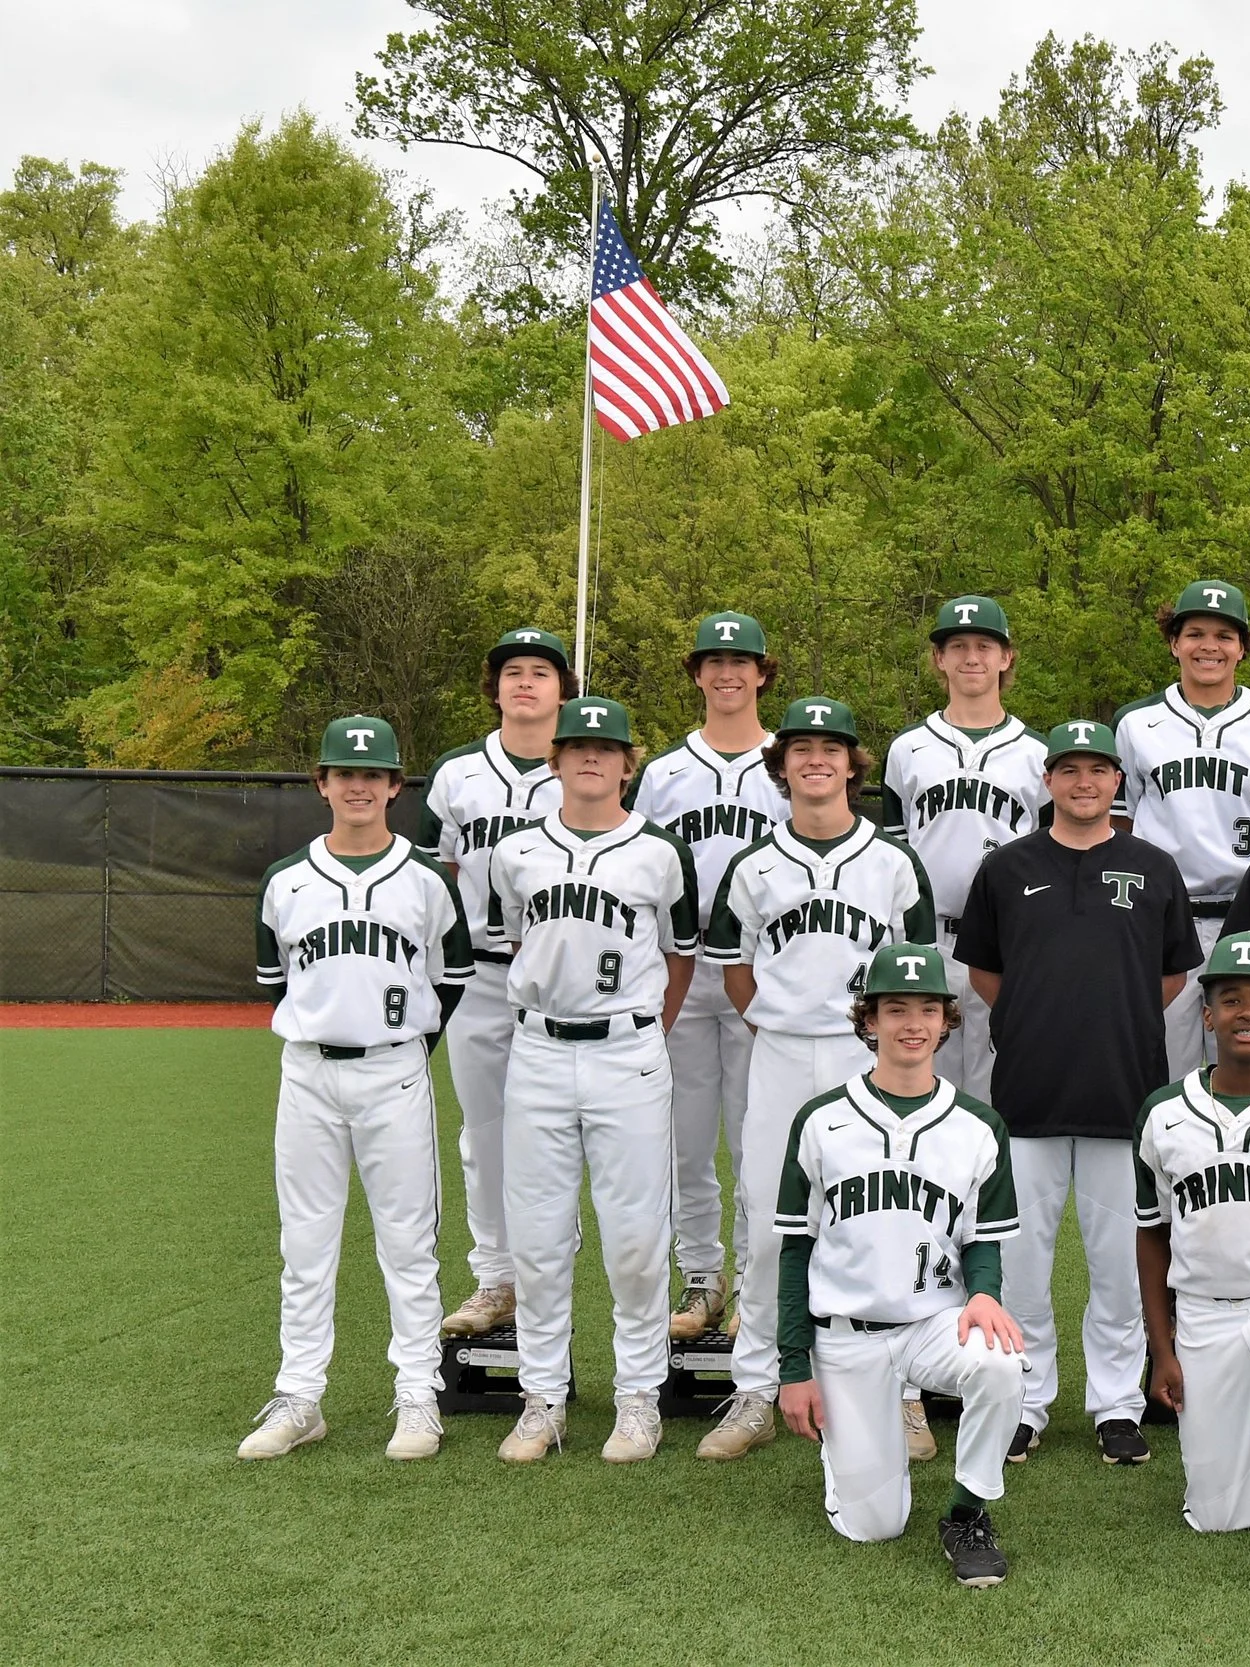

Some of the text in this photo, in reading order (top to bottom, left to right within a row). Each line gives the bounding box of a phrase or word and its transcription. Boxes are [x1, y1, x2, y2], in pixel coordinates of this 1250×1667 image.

[1202, 588, 1227, 609] T
[954, 604, 979, 625] T
[715, 621, 740, 641] T
[580, 706, 608, 728] T
[805, 704, 832, 726] T
[346, 729, 375, 751] T
[1067, 723, 1095, 745] T
[915, 777, 1025, 834] TRINITY
[1102, 870, 1144, 909] T
[766, 899, 887, 956] TRINITY
[596, 950, 623, 995] 9
[896, 956, 926, 980] T
[382, 984, 409, 1030] 8
[825, 1170, 965, 1237] TRINITY
[913, 1242, 954, 1293] 14
[690, 1276, 707, 1285] NIKE
